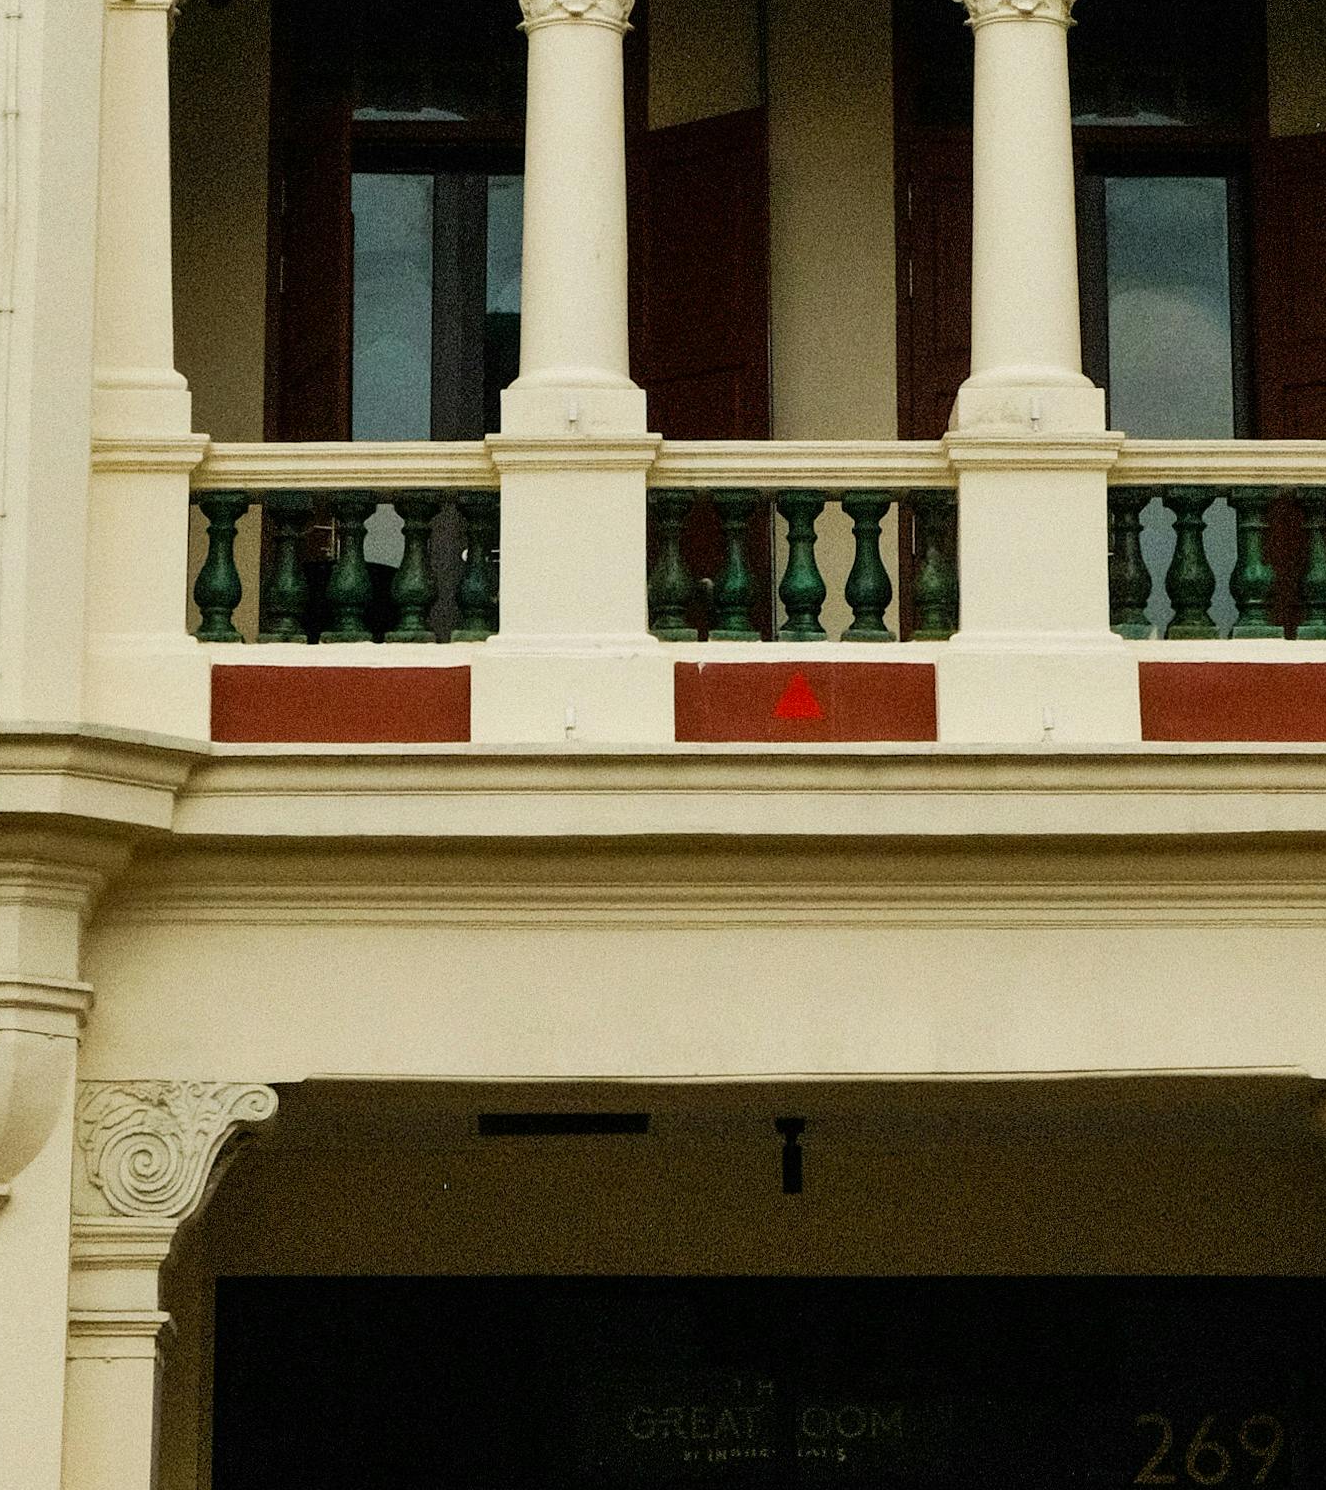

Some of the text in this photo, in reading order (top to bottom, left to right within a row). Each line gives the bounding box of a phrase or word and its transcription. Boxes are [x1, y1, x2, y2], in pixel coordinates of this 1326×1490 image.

[627, 1404, 904, 1440] GREAT OOM
[1132, 1411, 1285, 1485] 269
